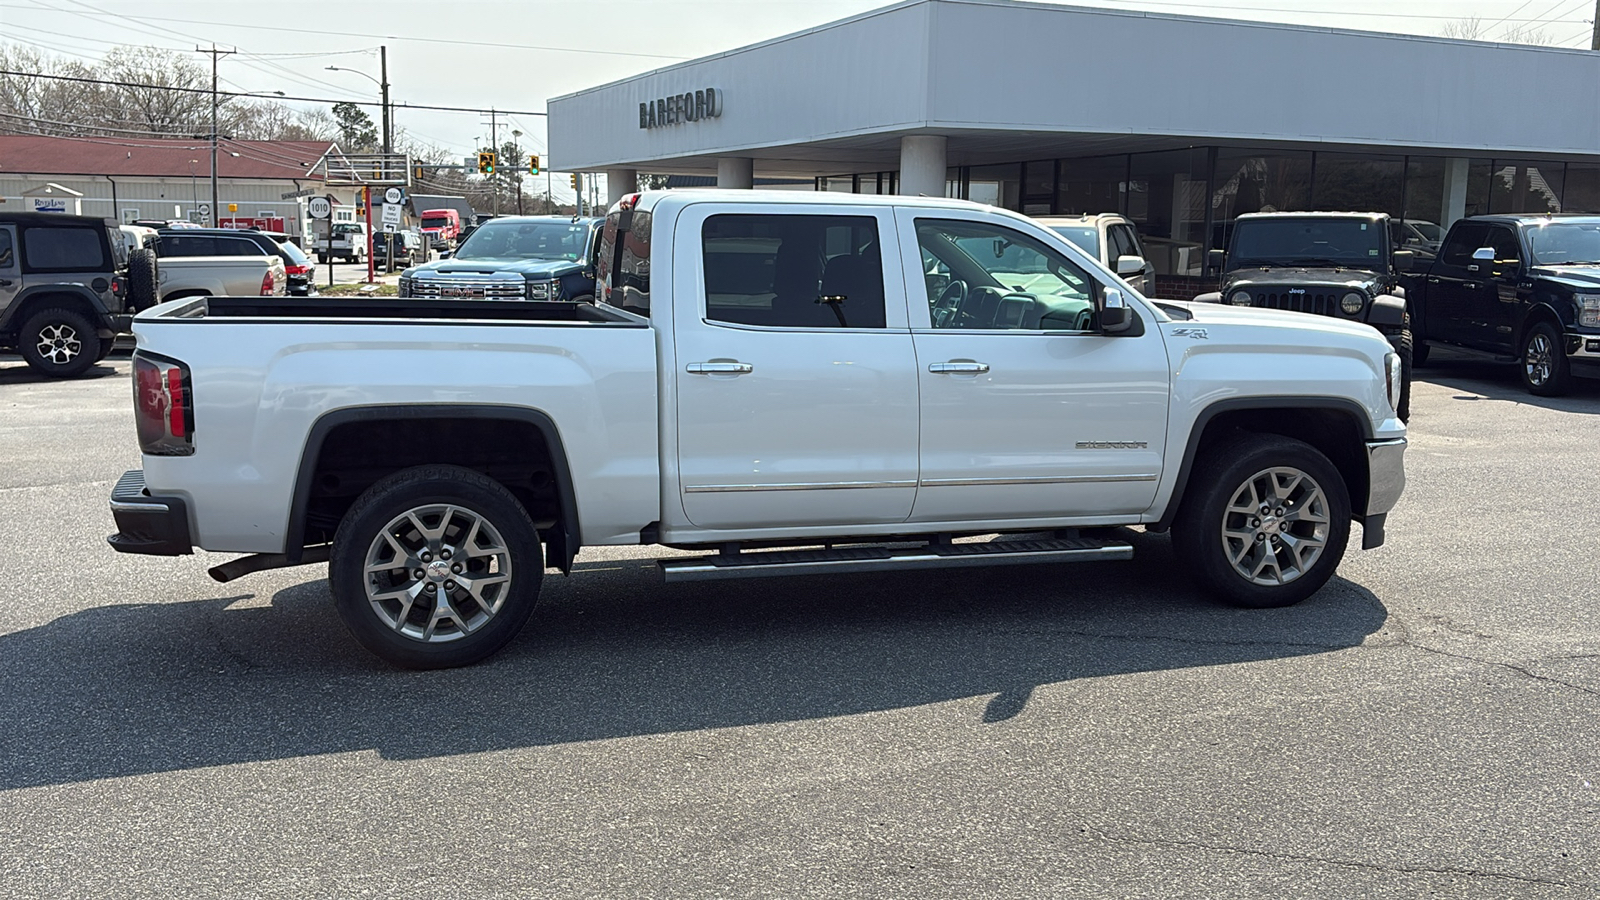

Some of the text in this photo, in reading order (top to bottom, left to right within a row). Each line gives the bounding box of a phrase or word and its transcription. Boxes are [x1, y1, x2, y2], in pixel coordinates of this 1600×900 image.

[639, 87, 722, 129] BAREFORD
[311, 203, 328, 212] 1010
[441, 287, 484, 297] GMC
[1288, 287, 1306, 295] Jeep
[1075, 440, 1148, 450] SIERRA
